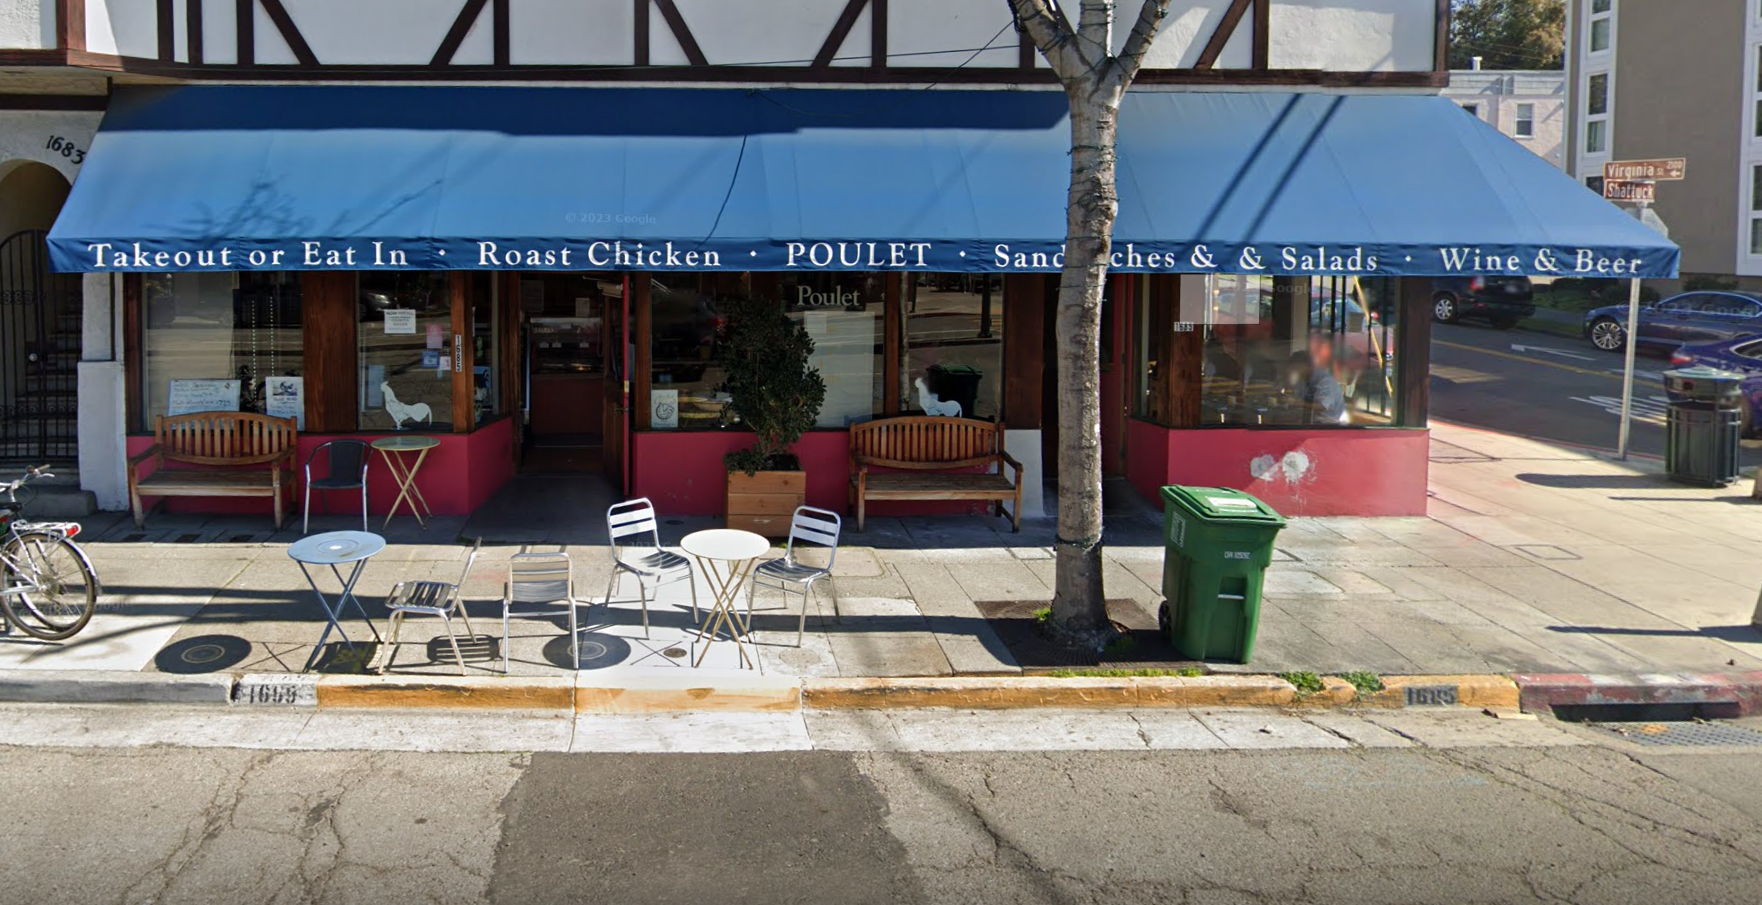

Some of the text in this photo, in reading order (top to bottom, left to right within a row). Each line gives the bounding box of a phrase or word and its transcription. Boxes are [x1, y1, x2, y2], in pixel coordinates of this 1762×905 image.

[45, 134, 87, 165] 1683
[1607, 163, 1655, 180] Virginia
[1607, 182, 1654, 199] Shattuck
[87, 240, 1642, 273] Takeout or Eat In Roast Chicken POULET Sandches & & Salads Wine & Beer
[797, 285, 861, 306] Poulet
